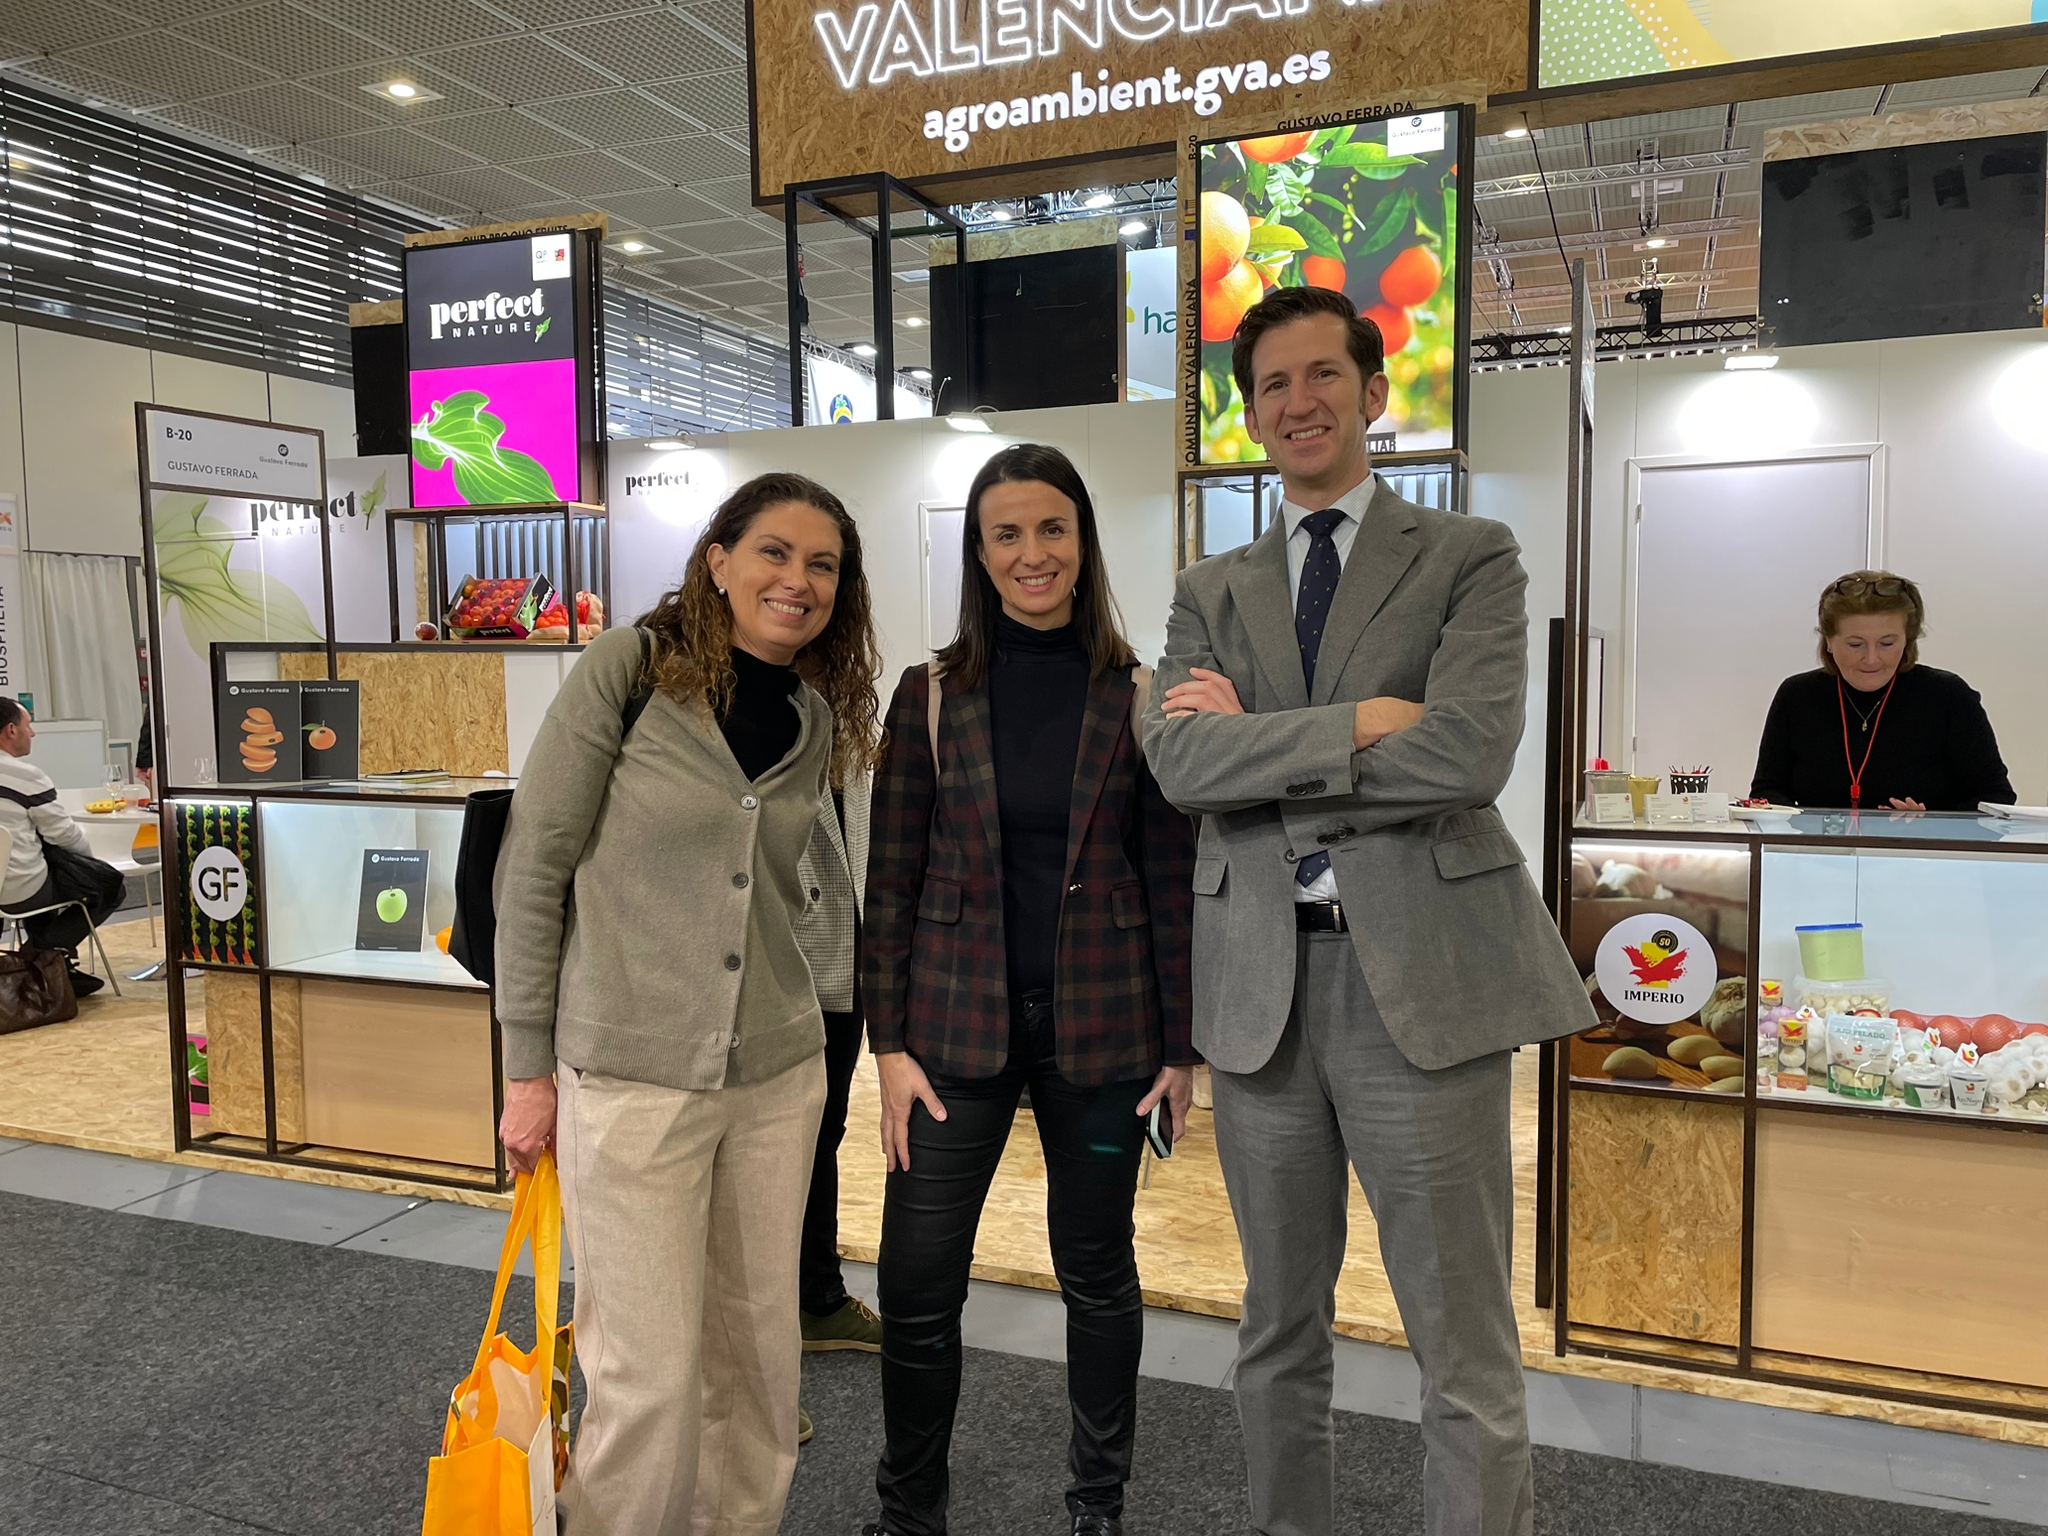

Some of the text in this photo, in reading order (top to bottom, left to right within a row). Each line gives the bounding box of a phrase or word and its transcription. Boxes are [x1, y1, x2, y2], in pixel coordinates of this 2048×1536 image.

[813, 0, 1376, 90] VALENC
[922, 49, 1332, 153] agroambient.gva.es
[1276, 101, 1414, 131] GUSTAVO FERRADA
[1188, 134, 1198, 160] B-20
[429, 287, 545, 340] perfect
[452, 321, 532, 338] NATURE
[1185, 278, 1198, 379] VALENCIANA
[166, 426, 193, 442] B-20
[1185, 383, 1197, 467] OMUNITAT
[167, 460, 259, 480] GUSTAVO FERRADA
[259, 456, 309, 468] Gustavo Ferrada
[625, 471, 690, 496] perfect
[198, 866, 240, 902] GF
[1659, 937, 1671, 947] 50
[1624, 989, 1685, 1004] IMPERIO
